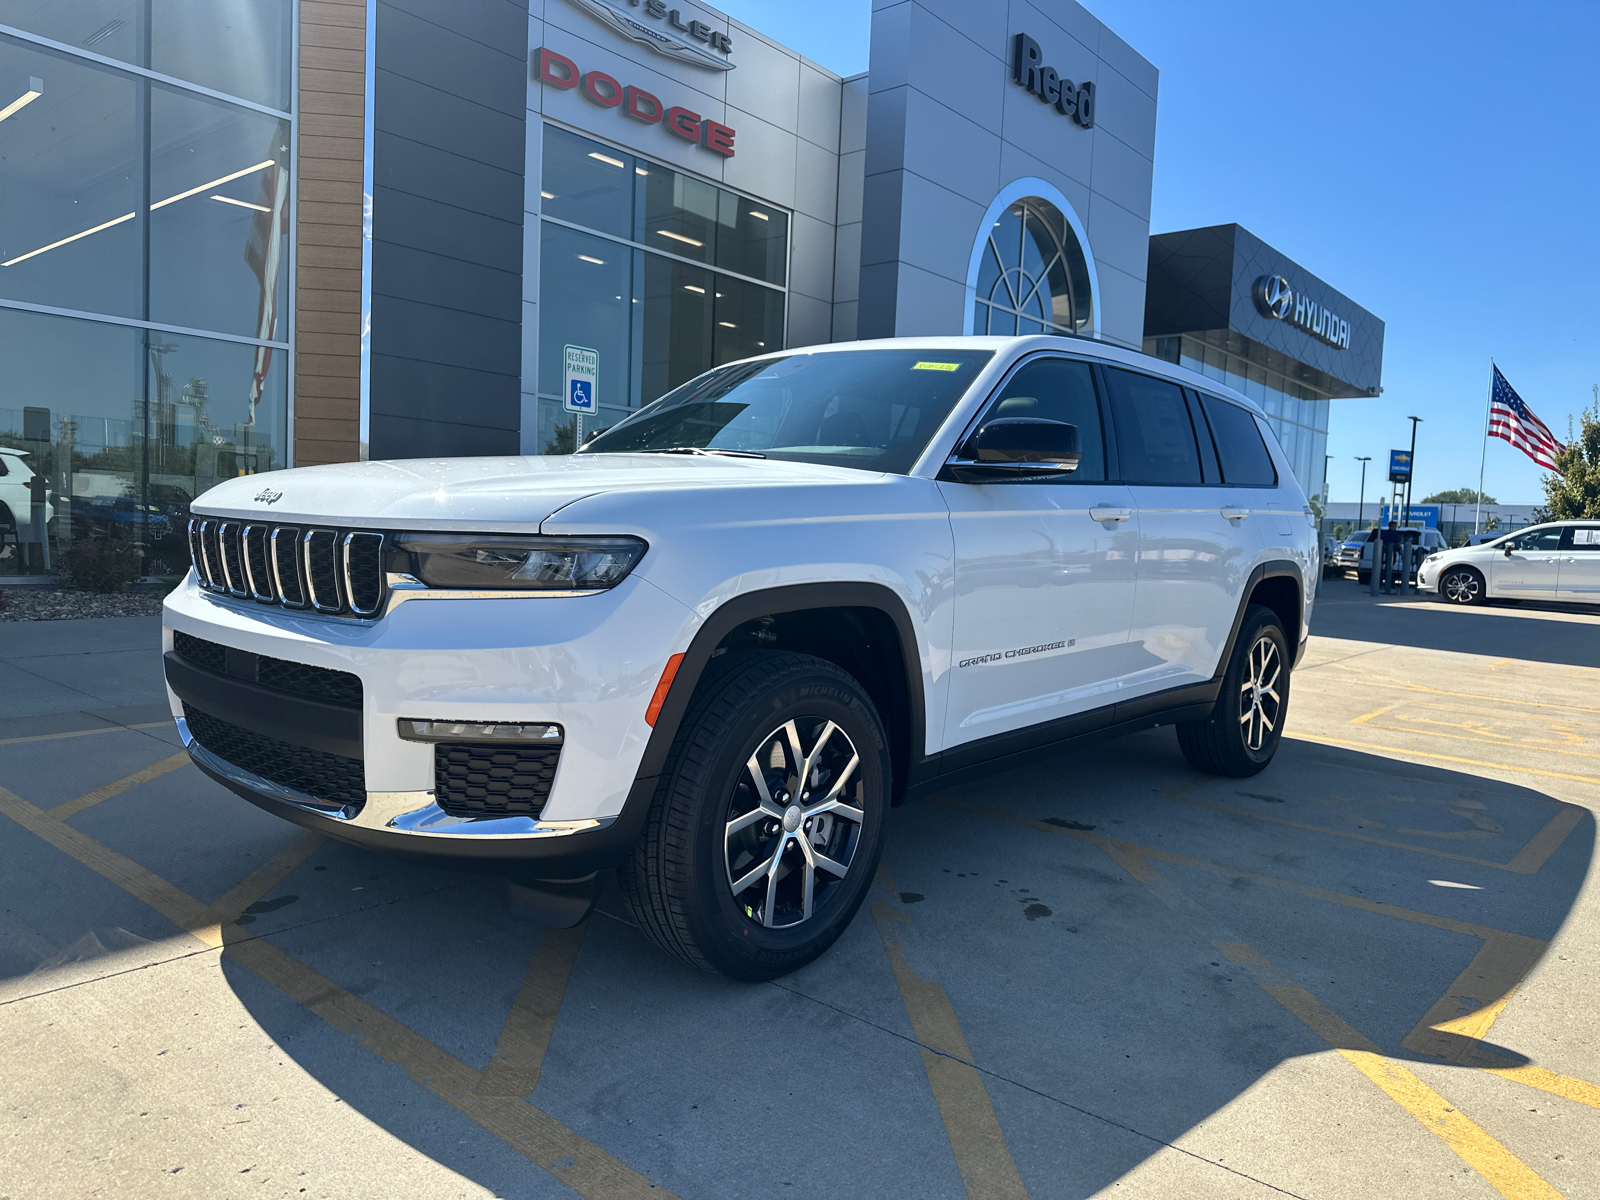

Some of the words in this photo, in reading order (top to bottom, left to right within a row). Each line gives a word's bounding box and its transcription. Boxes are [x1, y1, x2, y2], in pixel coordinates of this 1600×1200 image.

[1014, 32, 1096, 130] Reed
[534, 46, 736, 158] DODGE
[1294, 291, 1350, 350] HYUNDAI
[567, 351, 596, 365] RESERVED
[567, 362, 596, 376] PARKING
[254, 487, 283, 506] Jeep
[959, 652, 1003, 668] GRAND
[1004, 640, 1066, 659] CHEROKEE
[799, 685, 851, 704] MICHELIN
